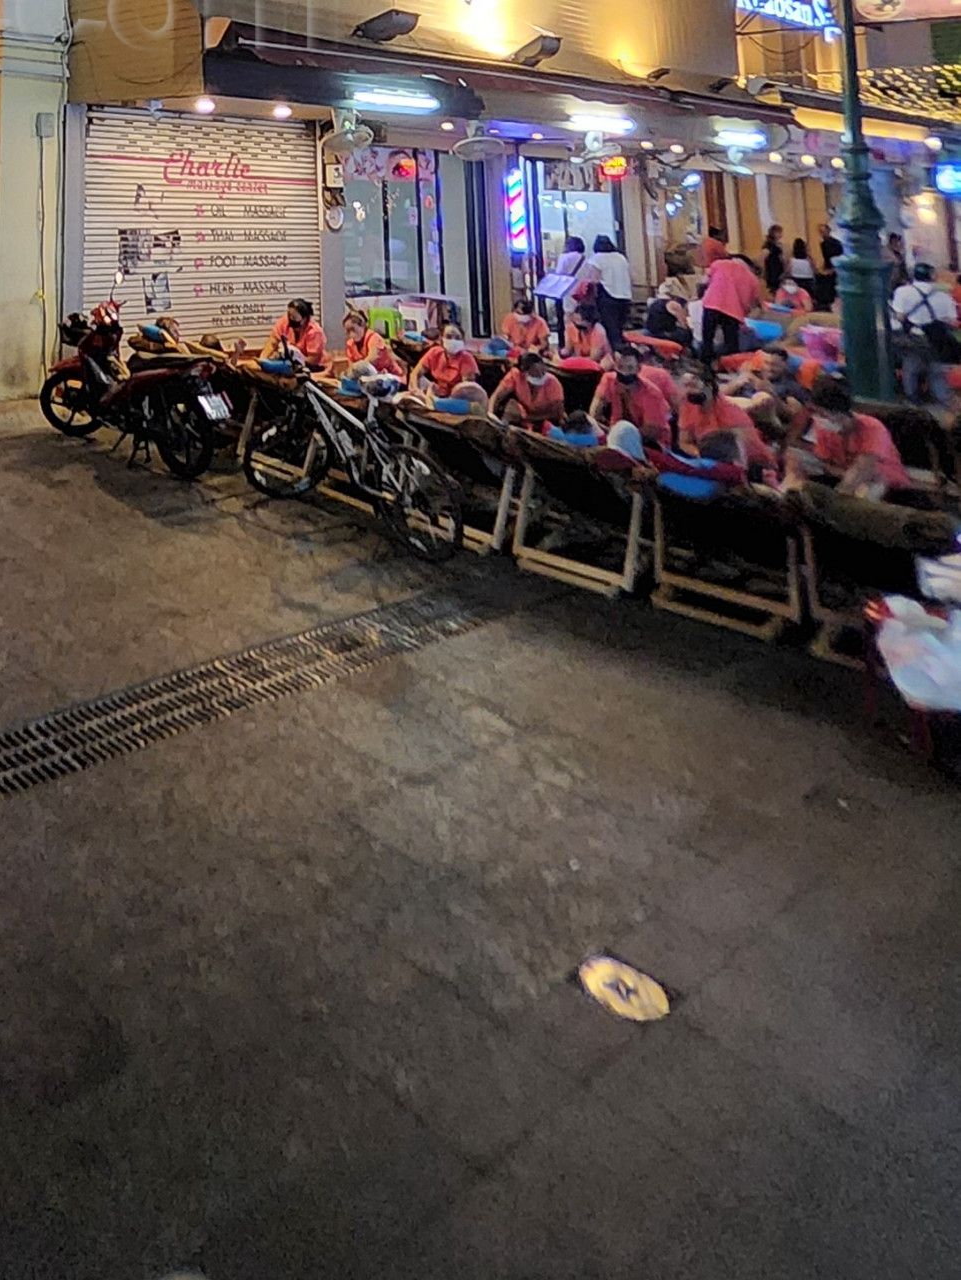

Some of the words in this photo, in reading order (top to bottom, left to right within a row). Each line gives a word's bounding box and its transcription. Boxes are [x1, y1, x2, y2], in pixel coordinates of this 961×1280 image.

[163, 148, 250, 185] Charlie
[210, 255, 237, 267] FOOT
[243, 255, 287, 267] MASSAGE
[243, 281, 287, 294] MASSAGE
